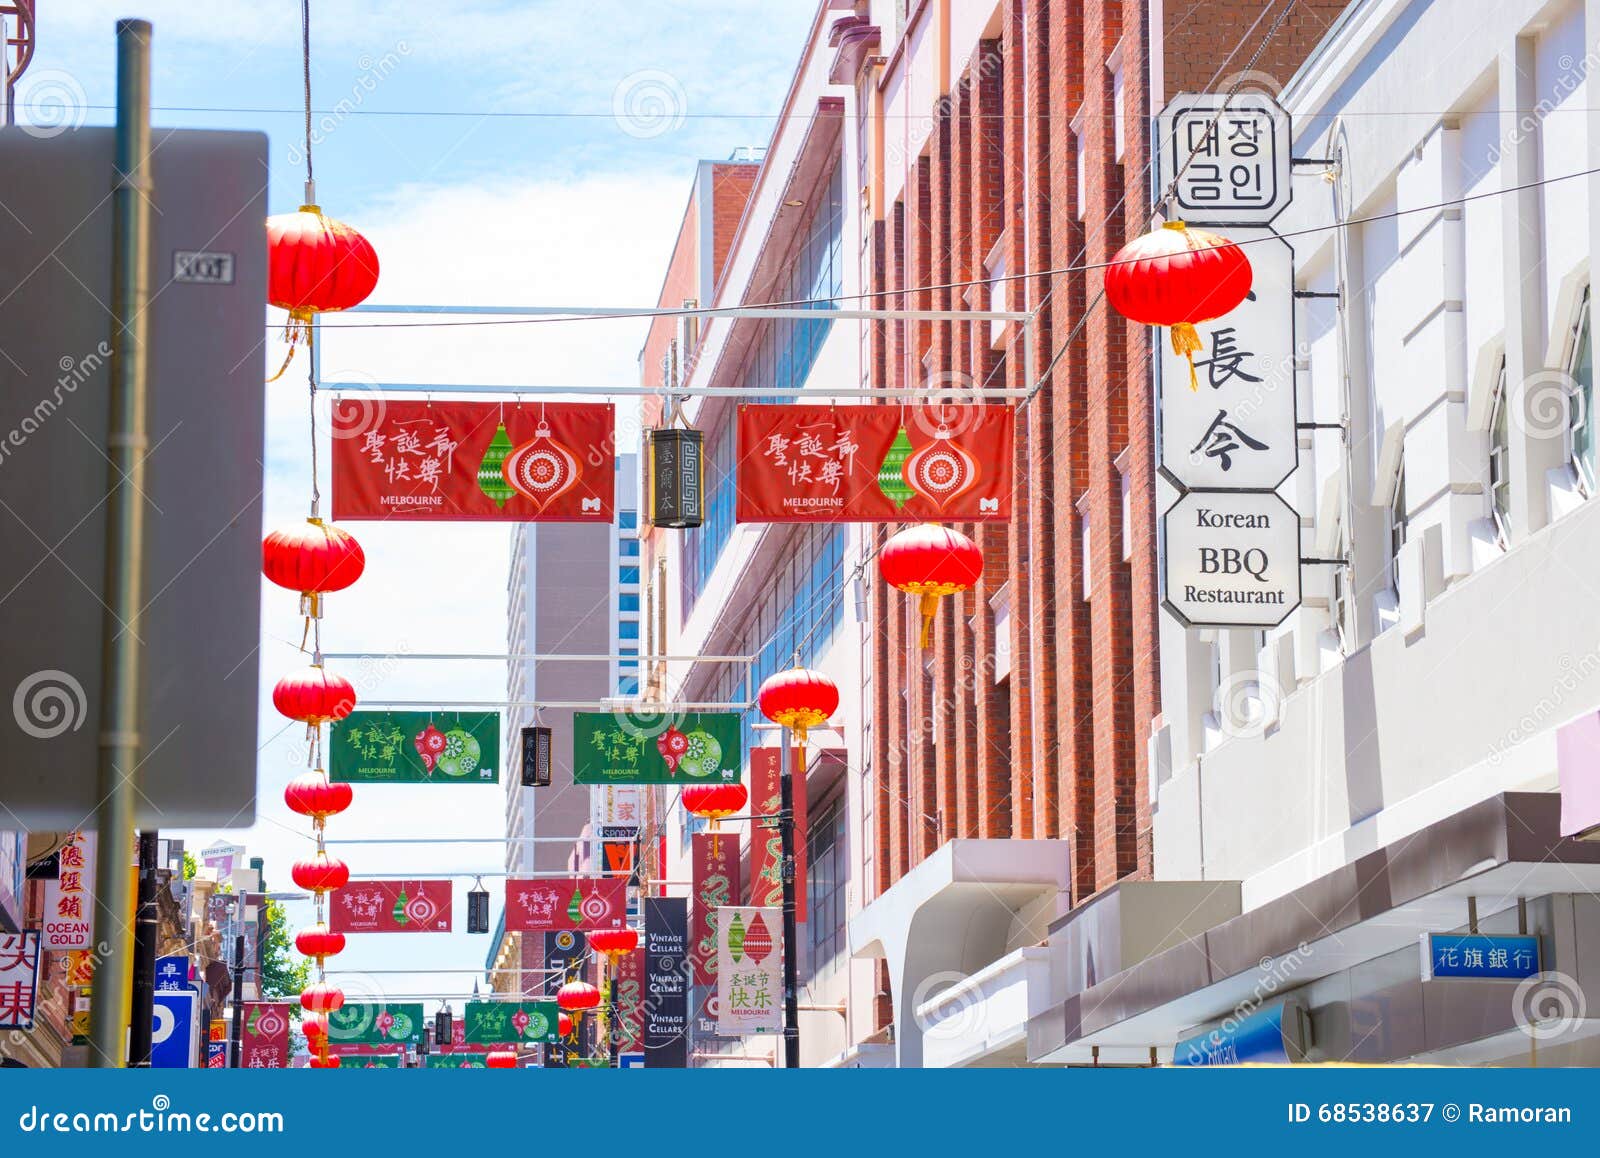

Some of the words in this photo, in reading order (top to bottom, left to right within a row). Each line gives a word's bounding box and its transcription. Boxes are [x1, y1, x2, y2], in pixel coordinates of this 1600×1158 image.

[1188, 120, 1263, 157] 대장
[1188, 164, 1263, 200] 금인
[1190, 288, 1270, 472] 長今
[360, 426, 457, 474] 聖誕節
[764, 431, 859, 476] 聖誕節
[385, 457, 443, 494] 快樂
[787, 459, 845, 496] 快樂
[380, 496, 442, 505] MELBOURNE
[783, 497, 844, 507] MELBOURNE
[1196, 508, 1270, 529] Korean
[1199, 548, 1269, 582] BBQ
[1184, 585, 1285, 604] Restaurant
[603, 829, 638, 838] SPORTS
[46, 923, 89, 933] OCEAN
[50, 935, 85, 945] GOLD
[650, 933, 682, 942] VINTAGE
[649, 943, 682, 952] CELLARS
[1439, 947, 1533, 969] 花旗銀行
[650, 973, 683, 982] VINTAGE
[730, 973, 770, 986] 圣诞节
[649, 983, 682, 993] CELLARS
[729, 988, 772, 1009] 快乐
[651, 1014, 683, 1023] VINTAGE
[649, 1024, 682, 1033] CELLARS
